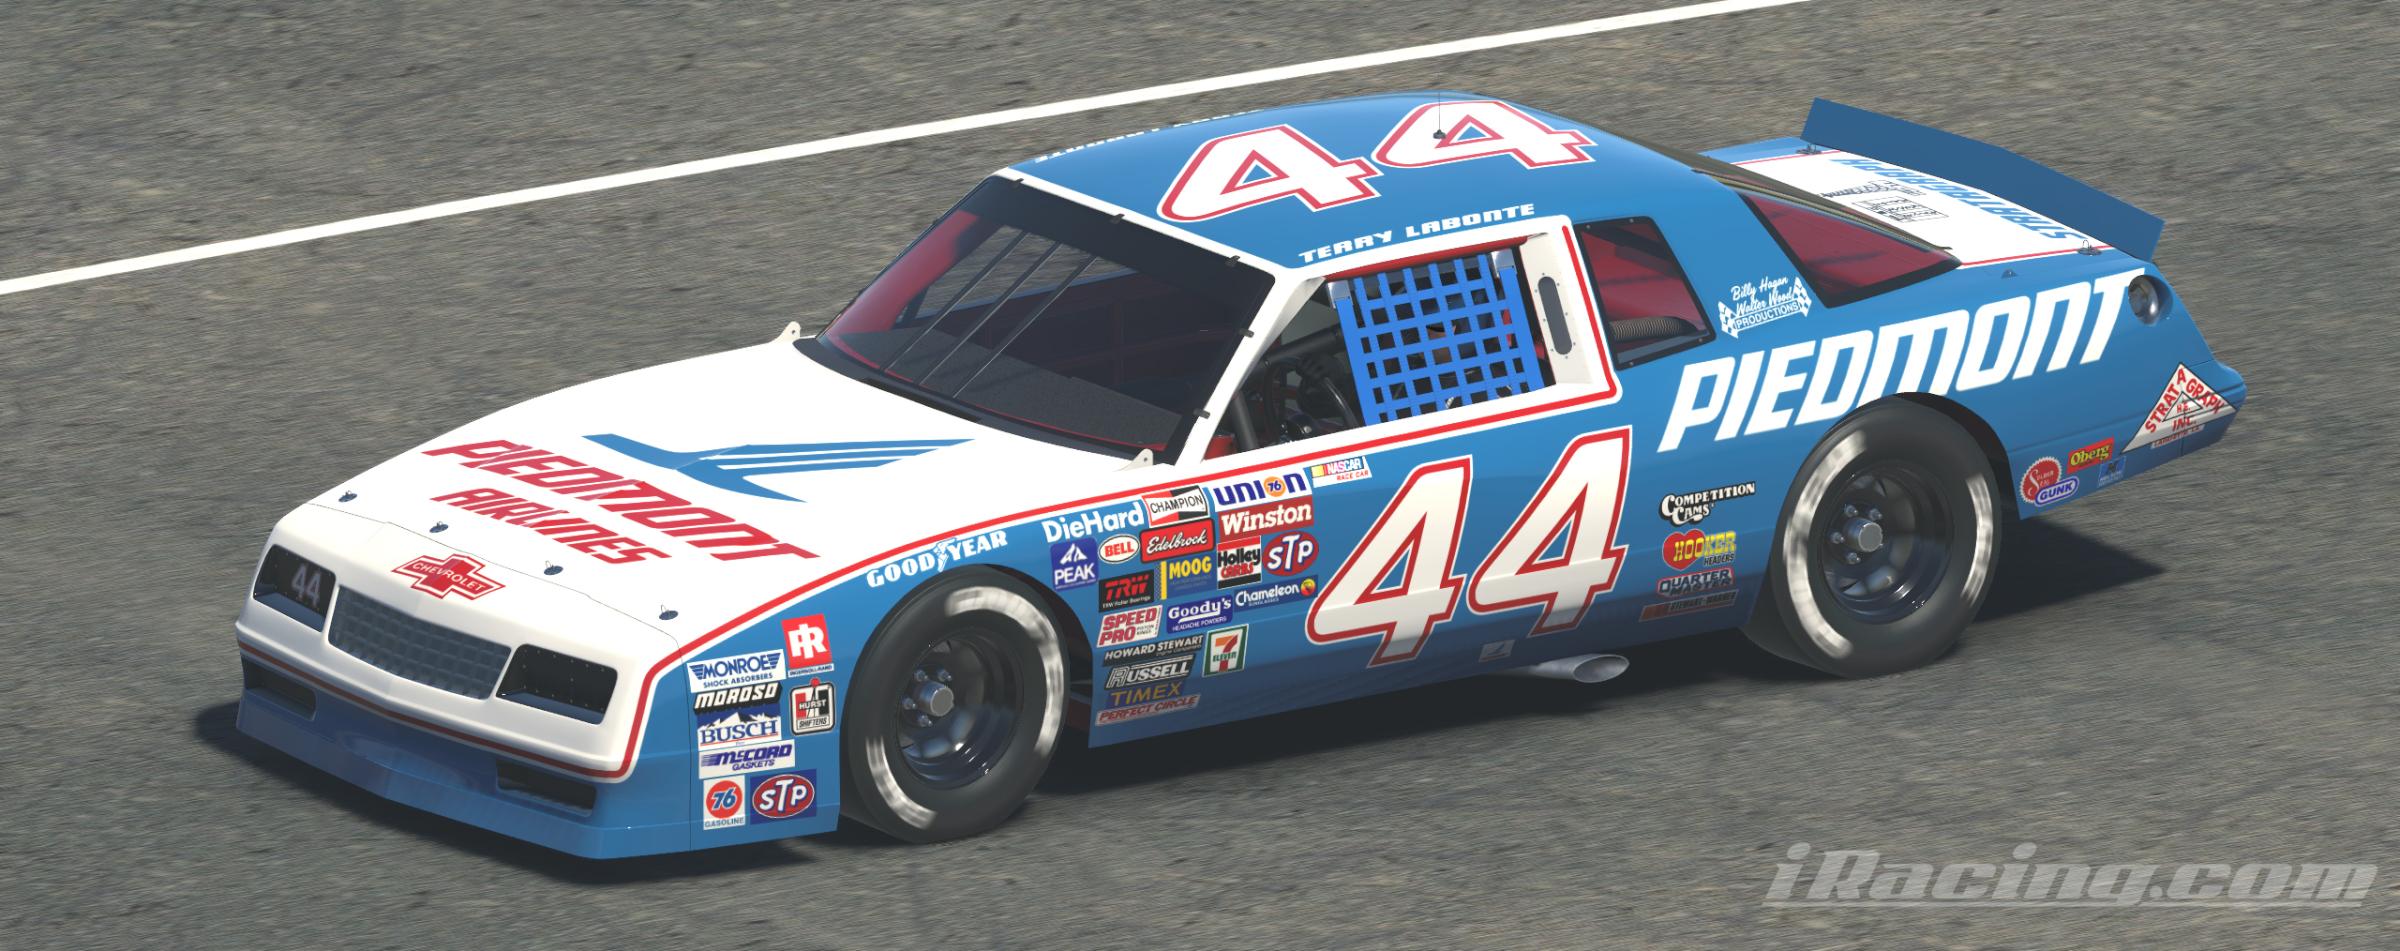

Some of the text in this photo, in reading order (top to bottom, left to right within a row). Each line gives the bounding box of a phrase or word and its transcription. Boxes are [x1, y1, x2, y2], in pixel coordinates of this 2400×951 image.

[1157, 99, 1599, 223] 44
[1298, 203, 1535, 263] TERRY LABONTE
[1731, 276, 1788, 301] Billy Hagan
[1735, 301, 1798, 329] PRODUCTIONS
[1736, 298, 1767, 316] Walter
[1656, 267, 2145, 453] PIEDMONT
[1327, 457, 1362, 475] NASCAR
[2070, 445, 2110, 466] Oberg
[1267, 480, 1282, 492] 76
[1337, 472, 1353, 480] RACE
[420, 439, 821, 561] PIEDMONT
[1661, 482, 1756, 517] COMPETITION
[2040, 482, 2073, 500] GUNK
[1150, 495, 1203, 514] CHAMPION
[1672, 504, 1711, 526] CAMS
[429, 487, 673, 564] AIRLINES
[1041, 501, 1145, 543] DieHard
[1221, 503, 1312, 536] Winston
[1104, 542, 1135, 557] BELL
[1146, 529, 1208, 555] Edelbrock
[1267, 534, 1314, 570] STP
[1305, 424, 1633, 669] 44
[1673, 531, 1737, 562] HOOKER
[1169, 556, 1212, 580] MOOG
[1217, 547, 1261, 568] Holley
[291, 563, 321, 606] 44
[412, 562, 485, 593] CHEVROLET
[1054, 563, 1096, 585] PEAK
[1659, 569, 1731, 593] QUARTER
[1105, 574, 1150, 601] TRW
[1235, 582, 1301, 607] Chameleon
[1103, 607, 1157, 630] SPEED
[1168, 597, 1232, 623] Goody's
[1099, 626, 1136, 645] PRO
[1172, 616, 1227, 632] HEADACHE POWDERS
[1104, 643, 1156, 660] HOWARD
[1157, 635, 1204, 651] STEWART
[703, 655, 772, 680] MONROE
[1106, 662, 1190, 689] RUSSELL
[703, 672, 773, 689] SHOCK ABSORBERS
[694, 682, 779, 709] MOROSO
[798, 699, 827, 710] HURST
[1111, 681, 1183, 707] TIMEX
[1099, 695, 1199, 722] PERFECT CIRCLE
[700, 720, 778, 744] BUSCH
[732, 759, 775, 771] GASKETS
[712, 787, 737, 809] 76
[759, 778, 807, 811] STP
[704, 816, 745, 828] GASOLINE
